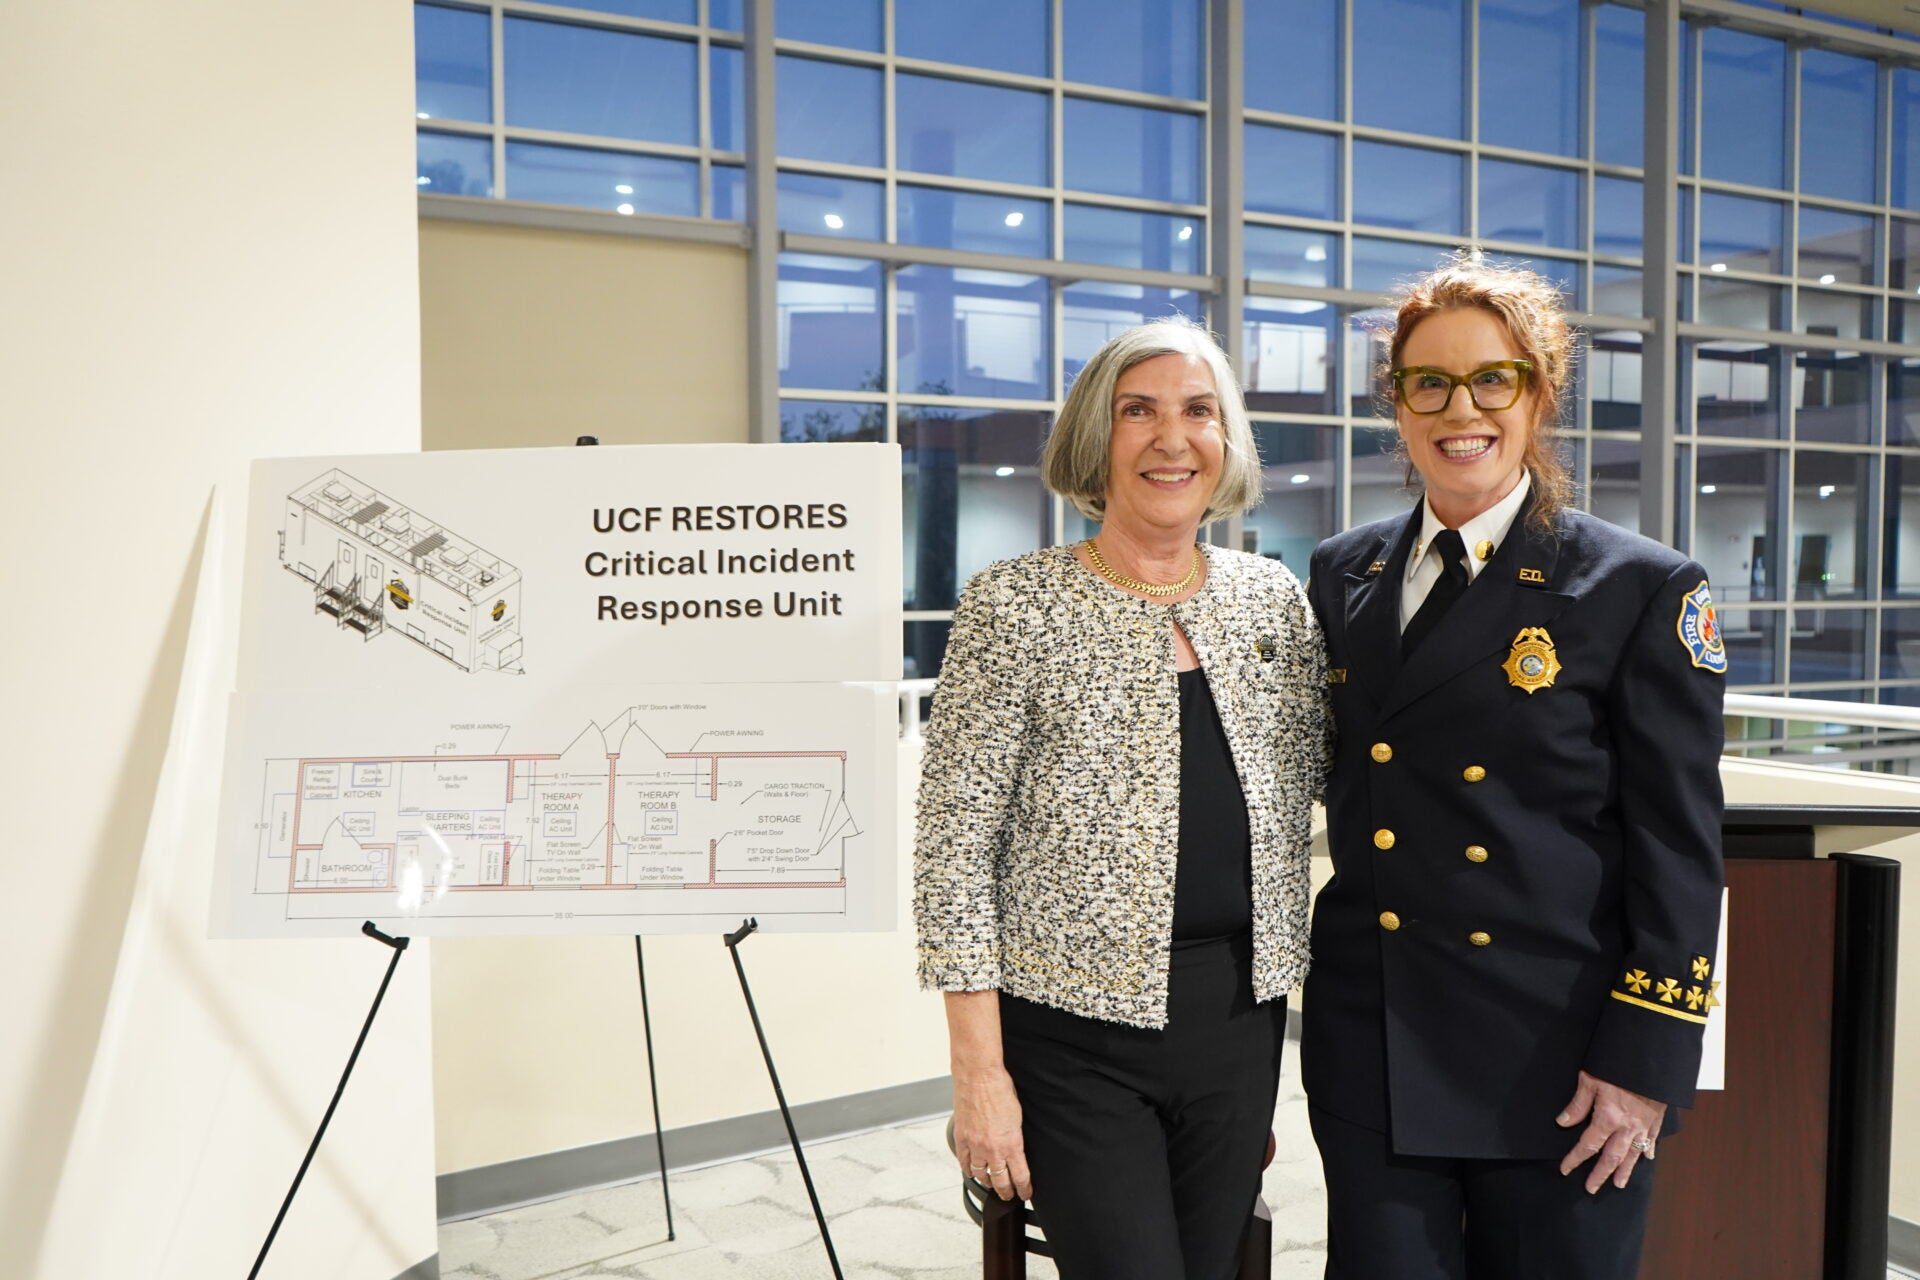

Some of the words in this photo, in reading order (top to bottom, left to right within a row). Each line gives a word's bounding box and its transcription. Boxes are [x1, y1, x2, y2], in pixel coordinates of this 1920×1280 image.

[593, 507, 662, 532] UCF
[672, 504, 848, 531] RESTORES
[585, 549, 707, 576] Critical
[717, 547, 855, 574] Incident
[597, 595, 763, 625] Response
[774, 591, 842, 616] Unit
[1685, 614, 1701, 646] FIRE
[344, 790, 381, 798] KITCHEN
[758, 815, 801, 823] STORAGE
[321, 864, 372, 872] BATHROOM
